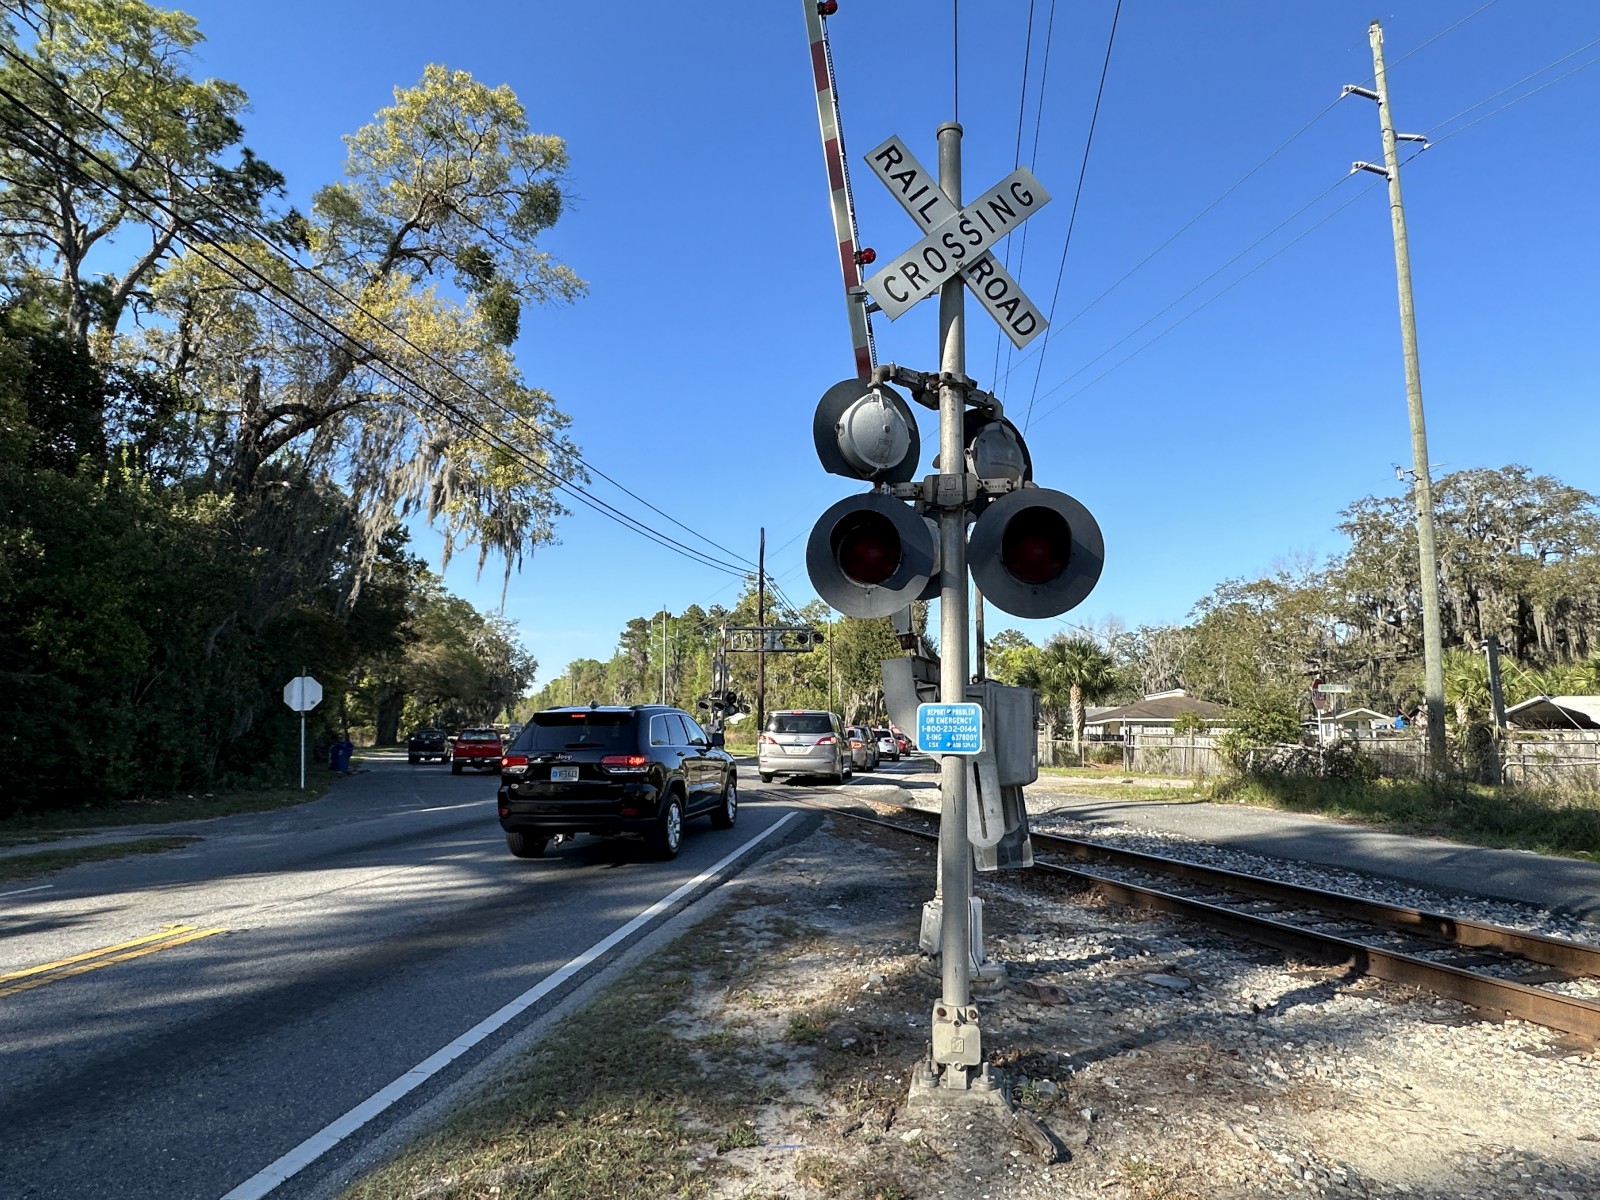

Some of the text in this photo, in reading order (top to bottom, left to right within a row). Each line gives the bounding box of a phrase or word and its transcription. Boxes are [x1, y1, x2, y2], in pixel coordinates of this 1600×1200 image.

[875, 144, 1037, 337] RAIL ROAD
[883, 182, 1034, 303] CROSSING
[927, 708, 976, 716] REPORT PROBLEM
[921, 725, 977, 733] 1-800-232-0144
[925, 733, 943, 741] X-ING
[555, 753, 573, 761] Jeep
